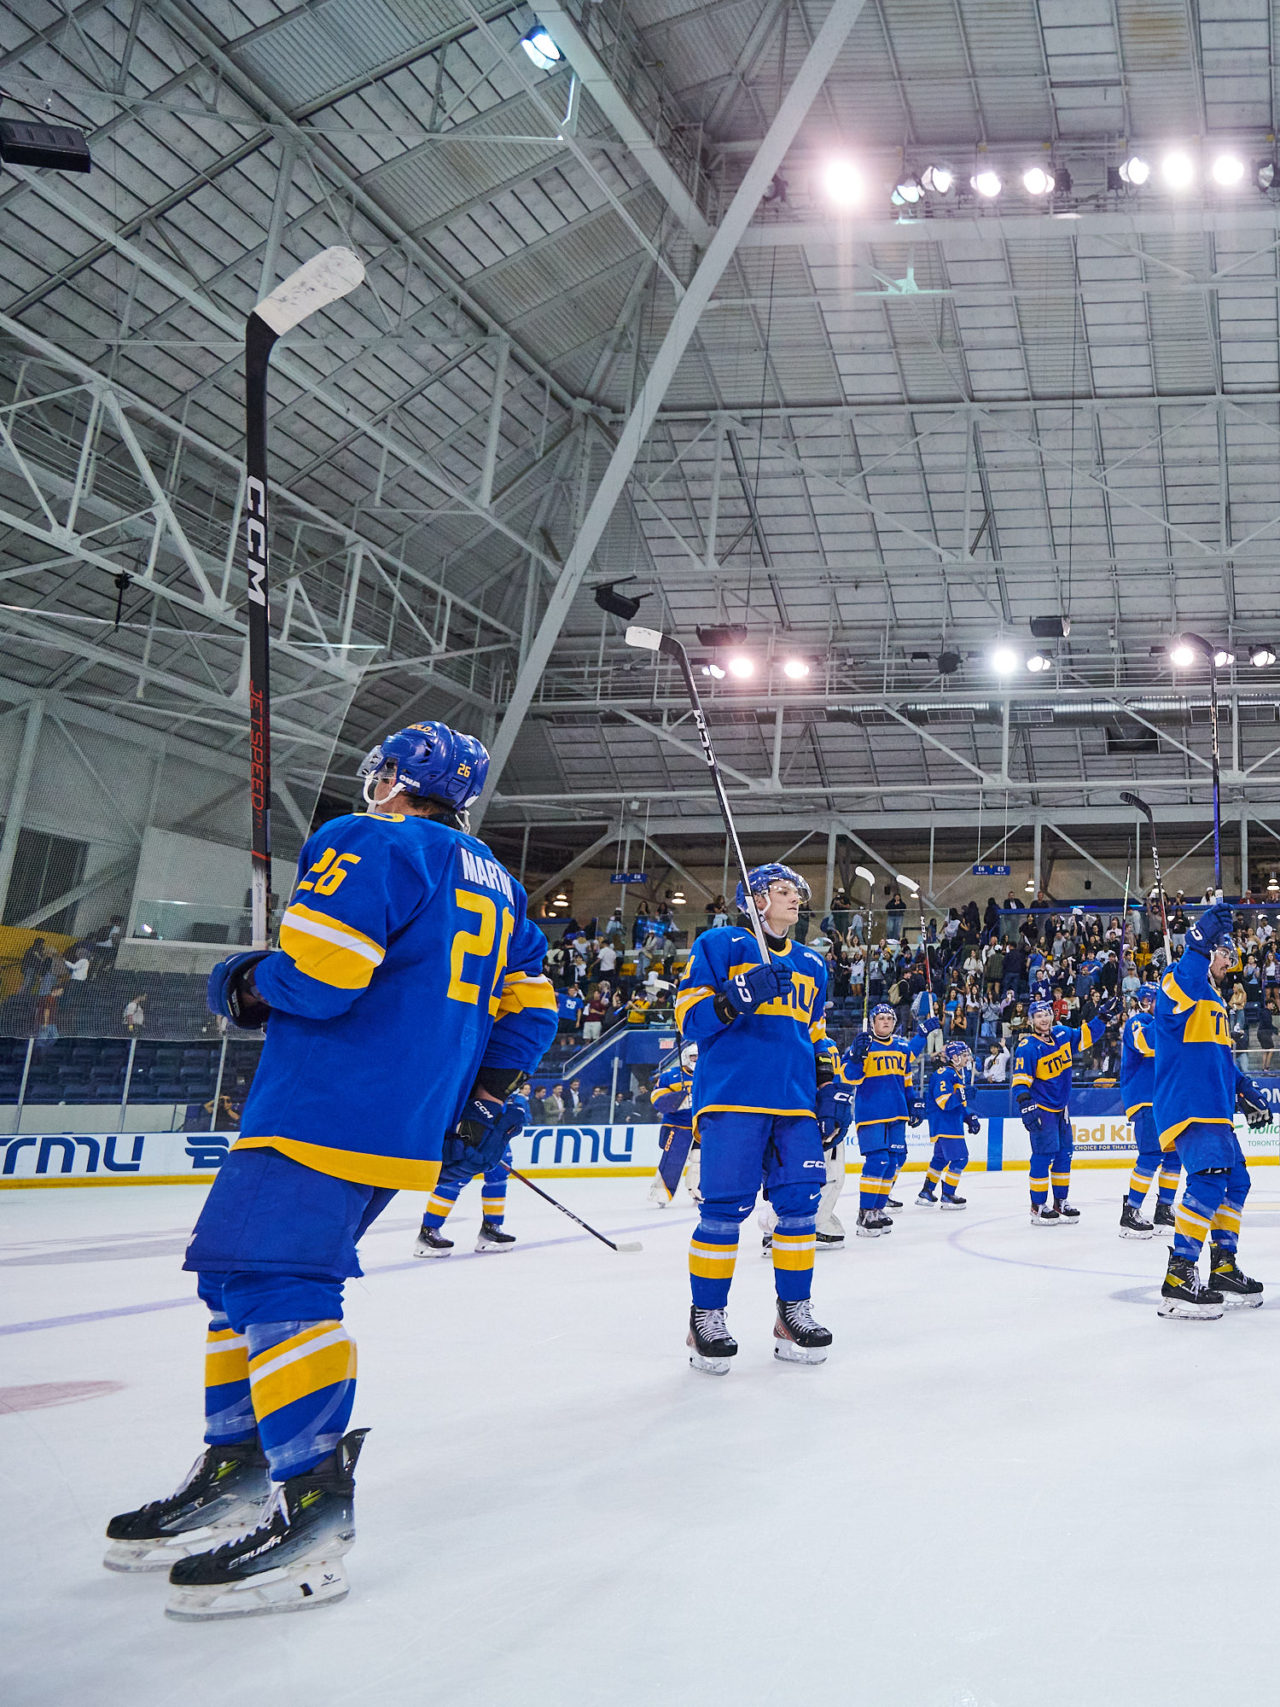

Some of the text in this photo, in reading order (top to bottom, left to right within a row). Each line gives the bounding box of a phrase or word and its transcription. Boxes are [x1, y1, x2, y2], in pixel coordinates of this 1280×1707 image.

[246, 475, 267, 607] CCM
[250, 680, 265, 811] JETSPEED
[693, 709, 715, 766] CCM
[457, 762, 472, 778] 26
[296, 847, 362, 897] 26
[940, 1080, 947, 1092] 2
[474, 1100, 494, 1119] CCM
[523, 1126, 636, 1165] TMU
[664, 1130, 675, 1152] CCM
[1110, 1122, 1137, 1142] Ki
[0, 1136, 145, 1174] TMU
